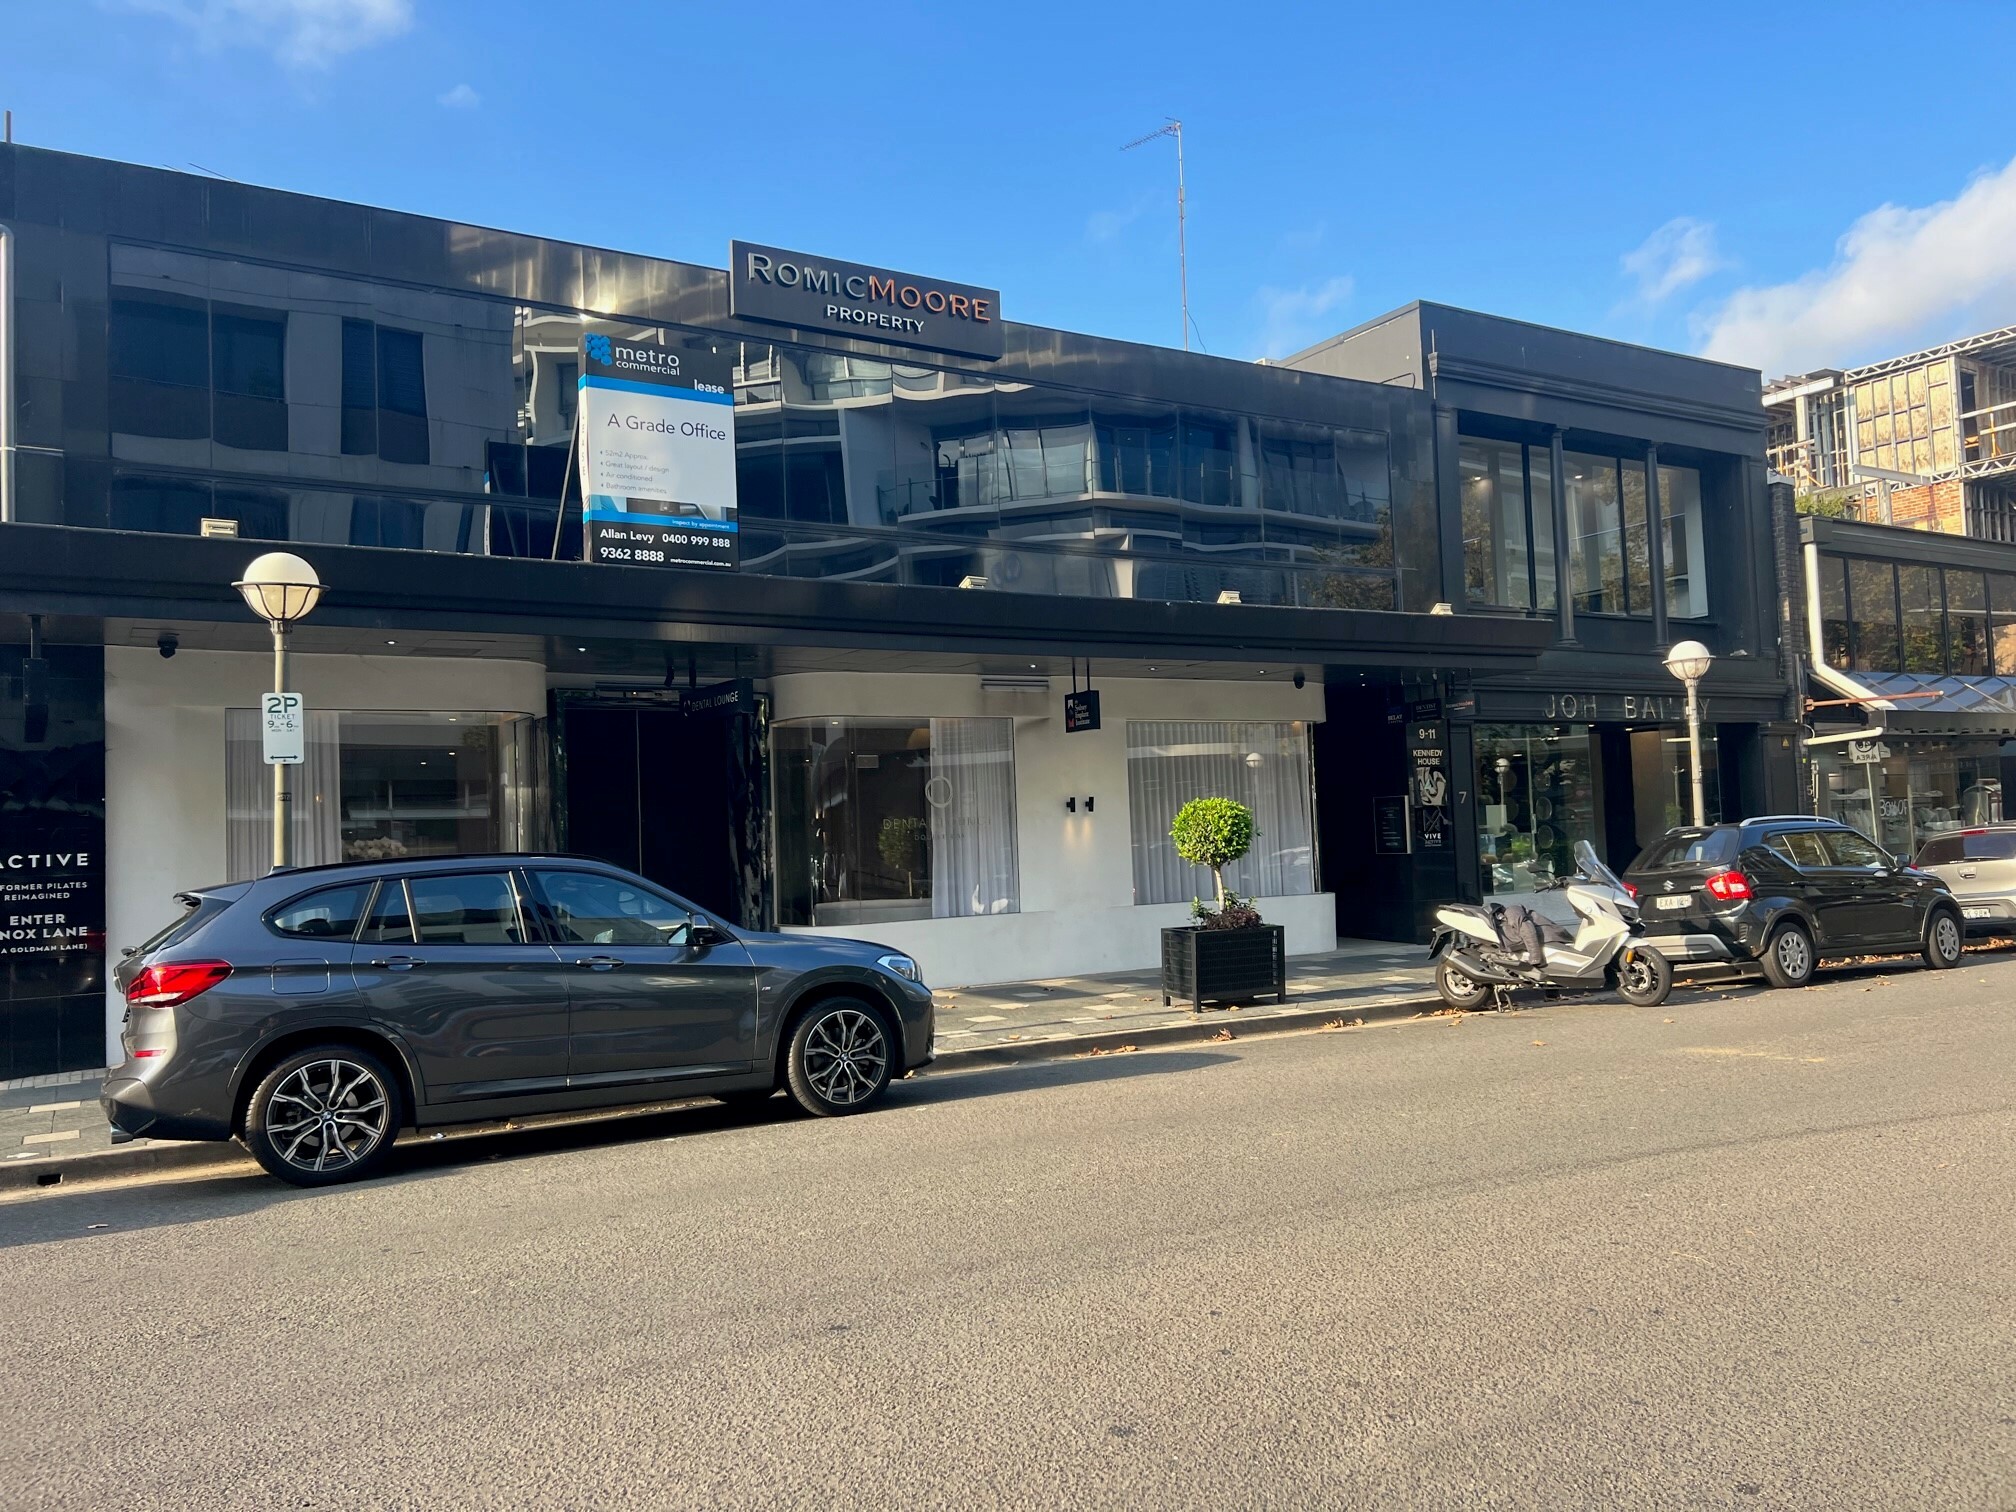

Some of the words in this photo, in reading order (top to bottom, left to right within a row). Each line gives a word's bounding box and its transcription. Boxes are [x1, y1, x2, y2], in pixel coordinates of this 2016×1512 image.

[826, 304, 925, 333] PROPERTY
[615, 346, 680, 367] metro
[616, 359, 680, 376] commercial
[694, 379, 725, 394] lease
[607, 413, 620, 428] A
[626, 415, 675, 434] Grade
[680, 422, 726, 440] Office
[605, 460, 623, 468] Great
[624, 462, 643, 471] layout
[649, 466, 670, 474] design
[616, 473, 653, 482] conditioned
[606, 482, 636, 491] Bathroom
[691, 520, 698, 528] by
[699, 522, 730, 530] appointment
[600, 528, 627, 540] Allan
[630, 530, 655, 544] Levy
[662, 533, 688, 544] 0400
[690, 535, 709, 546] 999
[712, 537, 731, 548] 888
[600, 547, 631, 560] 9362
[634, 549, 665, 562] 8888
[670, 558, 731, 567] metrocommercial.com.au
[267, 697, 298, 713] 2P
[713, 690, 739, 707] LOUNGE
[1544, 694, 1597, 718] JOH
[1418, 728, 1436, 740] 9-11
[1412, 749, 1443, 757] KENNEDY
[1417, 757, 1440, 766] HOUSE
[1806, 785, 1813, 796] 5
[1458, 791, 1467, 804] 7
[883, 817, 932, 831] DENTA
[1424, 832, 1442, 840] VIVE
[47, 881, 88, 890] PILATES
[4, 892, 71, 901] REIMAGINED
[9, 913, 66, 926] ENTER
[0, 928, 37, 941] NOX
[43, 926, 88, 938] LANE
[10, 945, 57, 953] GOLDMAN
